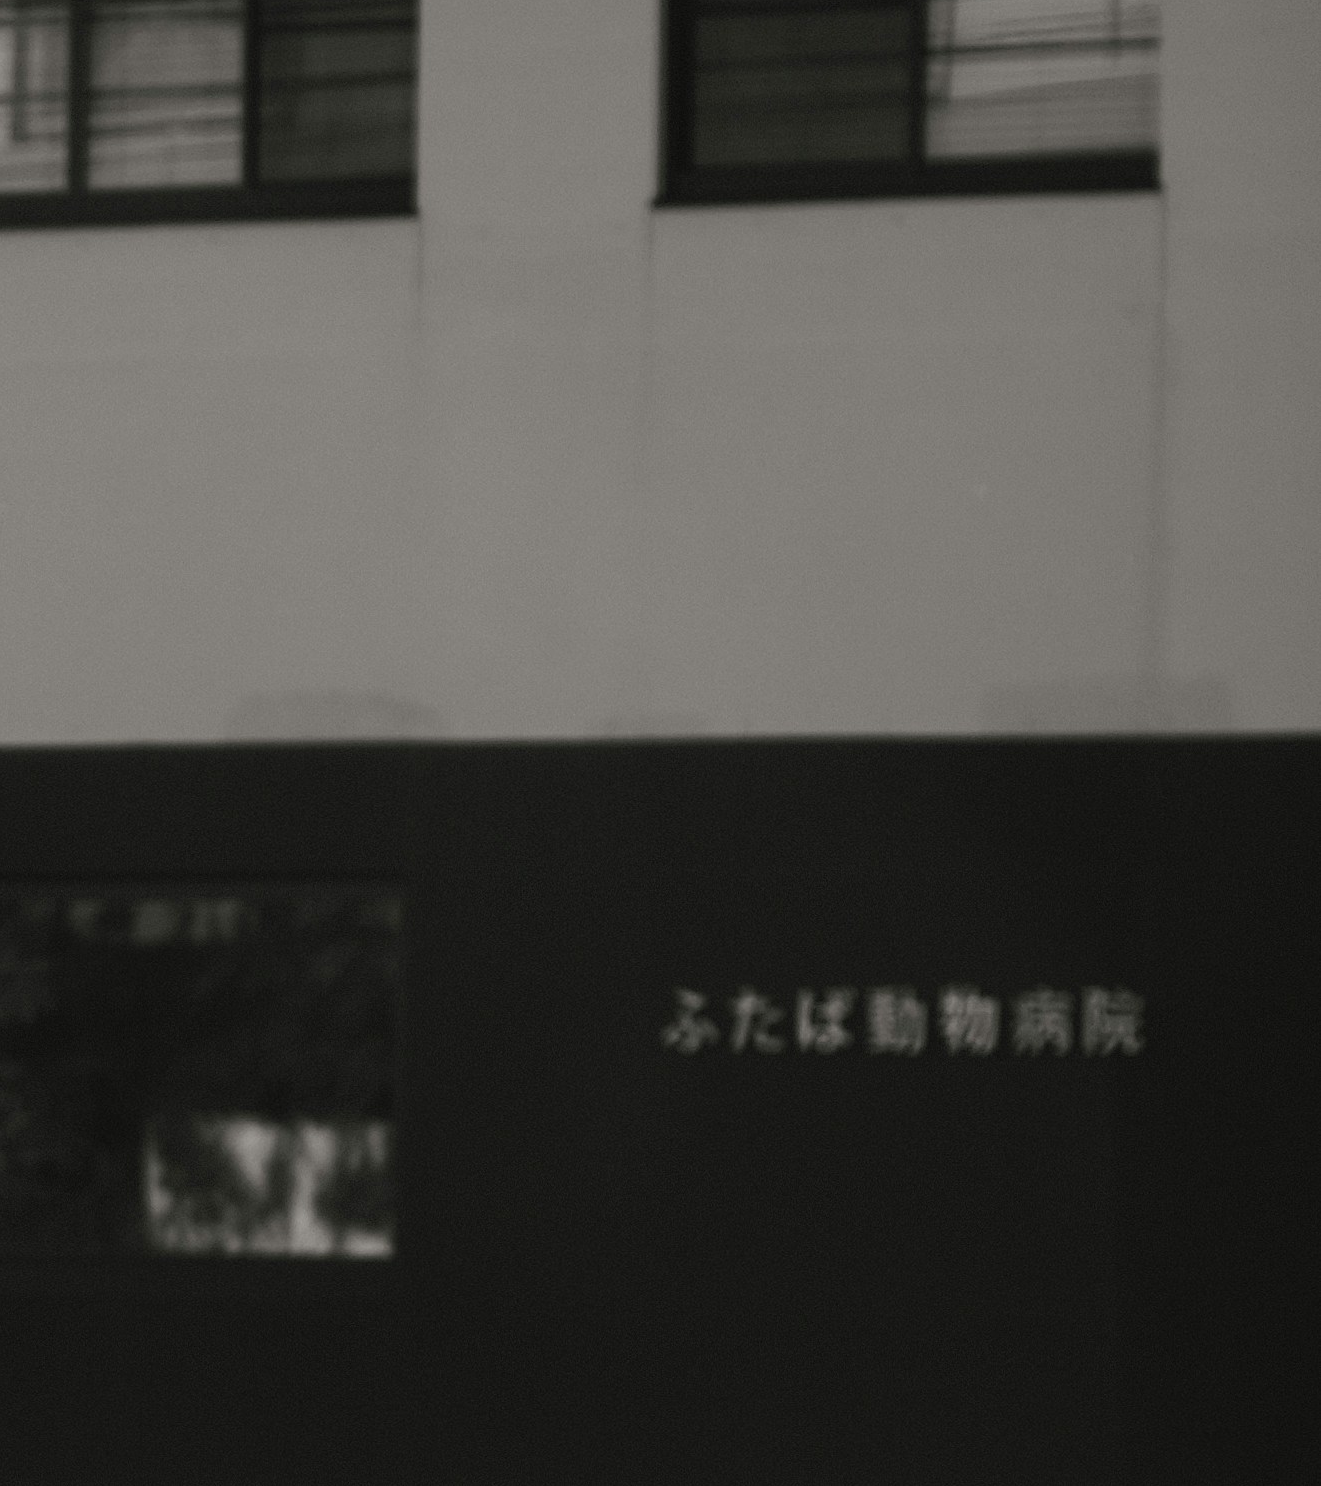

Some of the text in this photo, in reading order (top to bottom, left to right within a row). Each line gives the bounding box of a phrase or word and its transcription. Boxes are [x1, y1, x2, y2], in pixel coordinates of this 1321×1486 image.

[663, 987, 1146, 1055] ふたば動物病院
